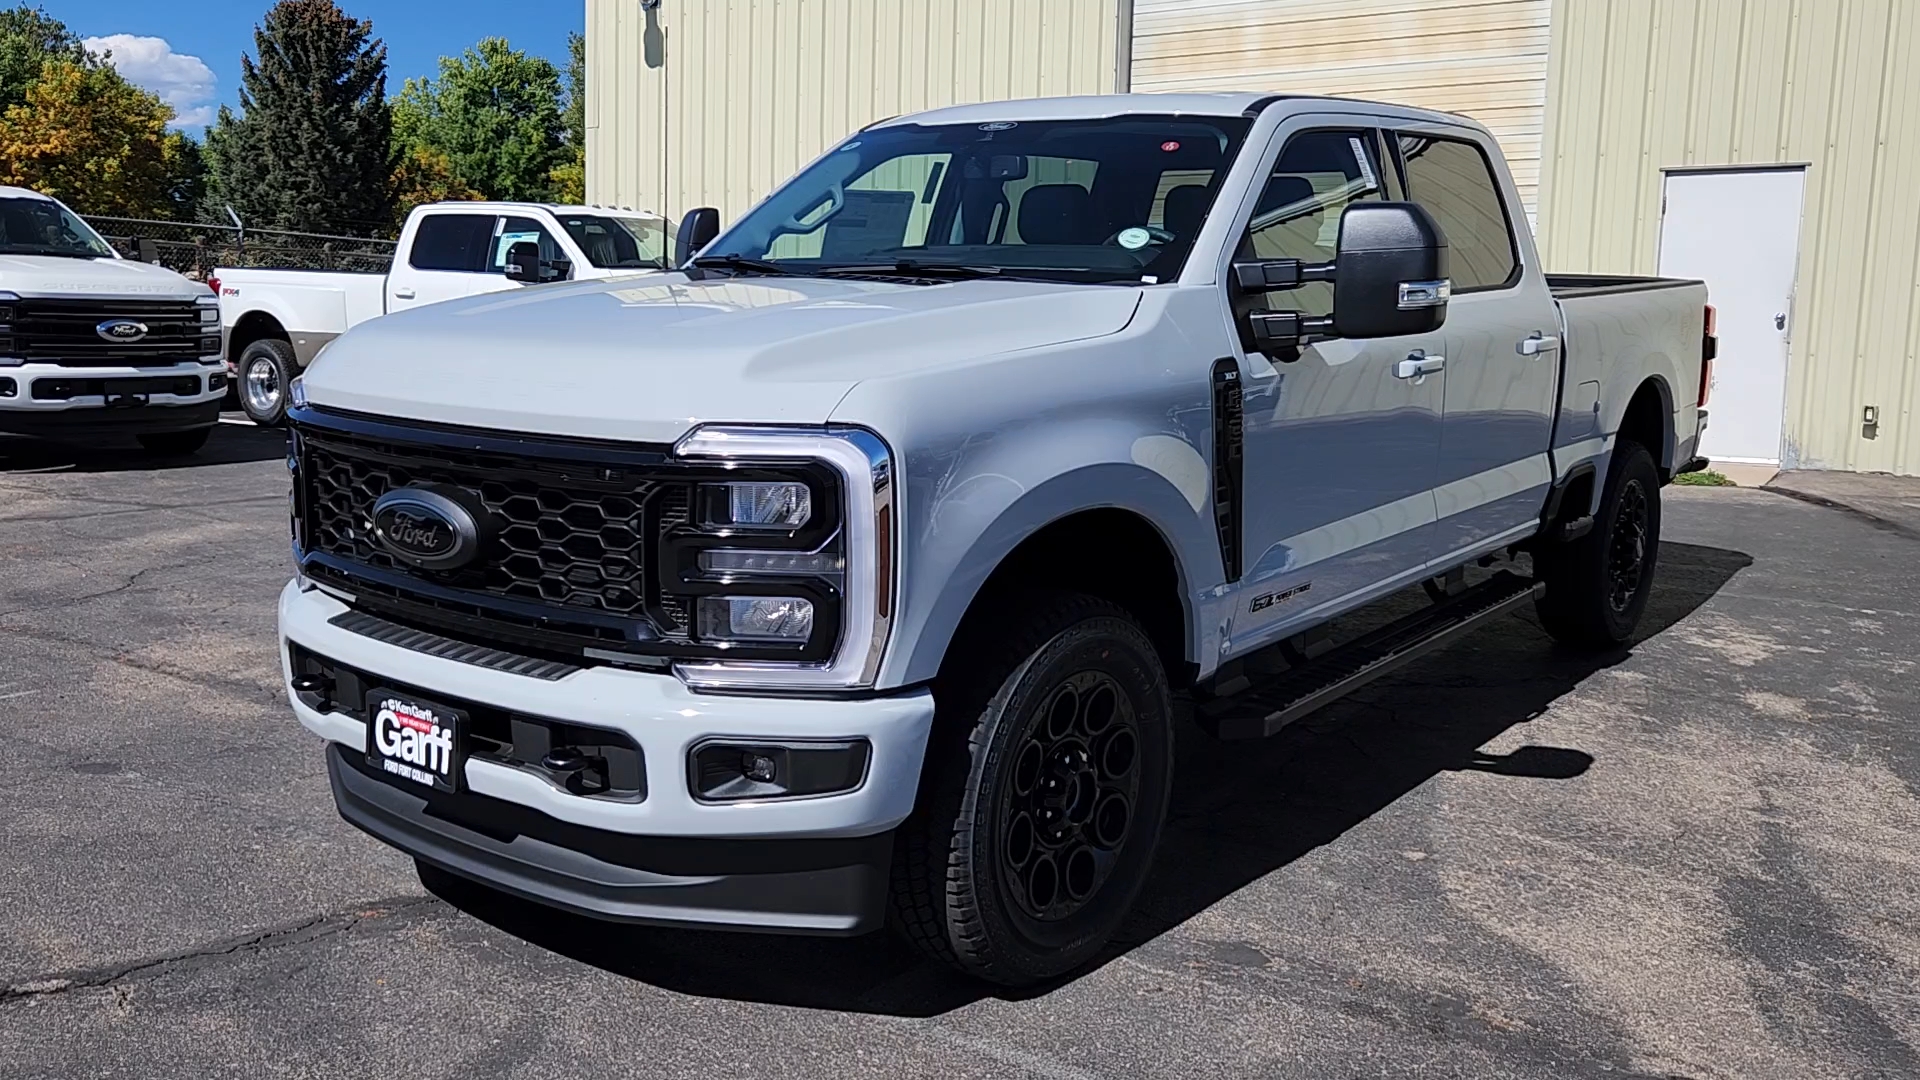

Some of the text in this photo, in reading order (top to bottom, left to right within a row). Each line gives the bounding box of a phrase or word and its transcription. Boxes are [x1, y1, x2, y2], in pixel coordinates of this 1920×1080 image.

[112, 325, 137, 336] Ford
[1224, 371, 1238, 380] XLT
[390, 511, 438, 548] Ford
[375, 709, 453, 775] Garff
[384, 759, 434, 786] FORD FORT COLLINS
